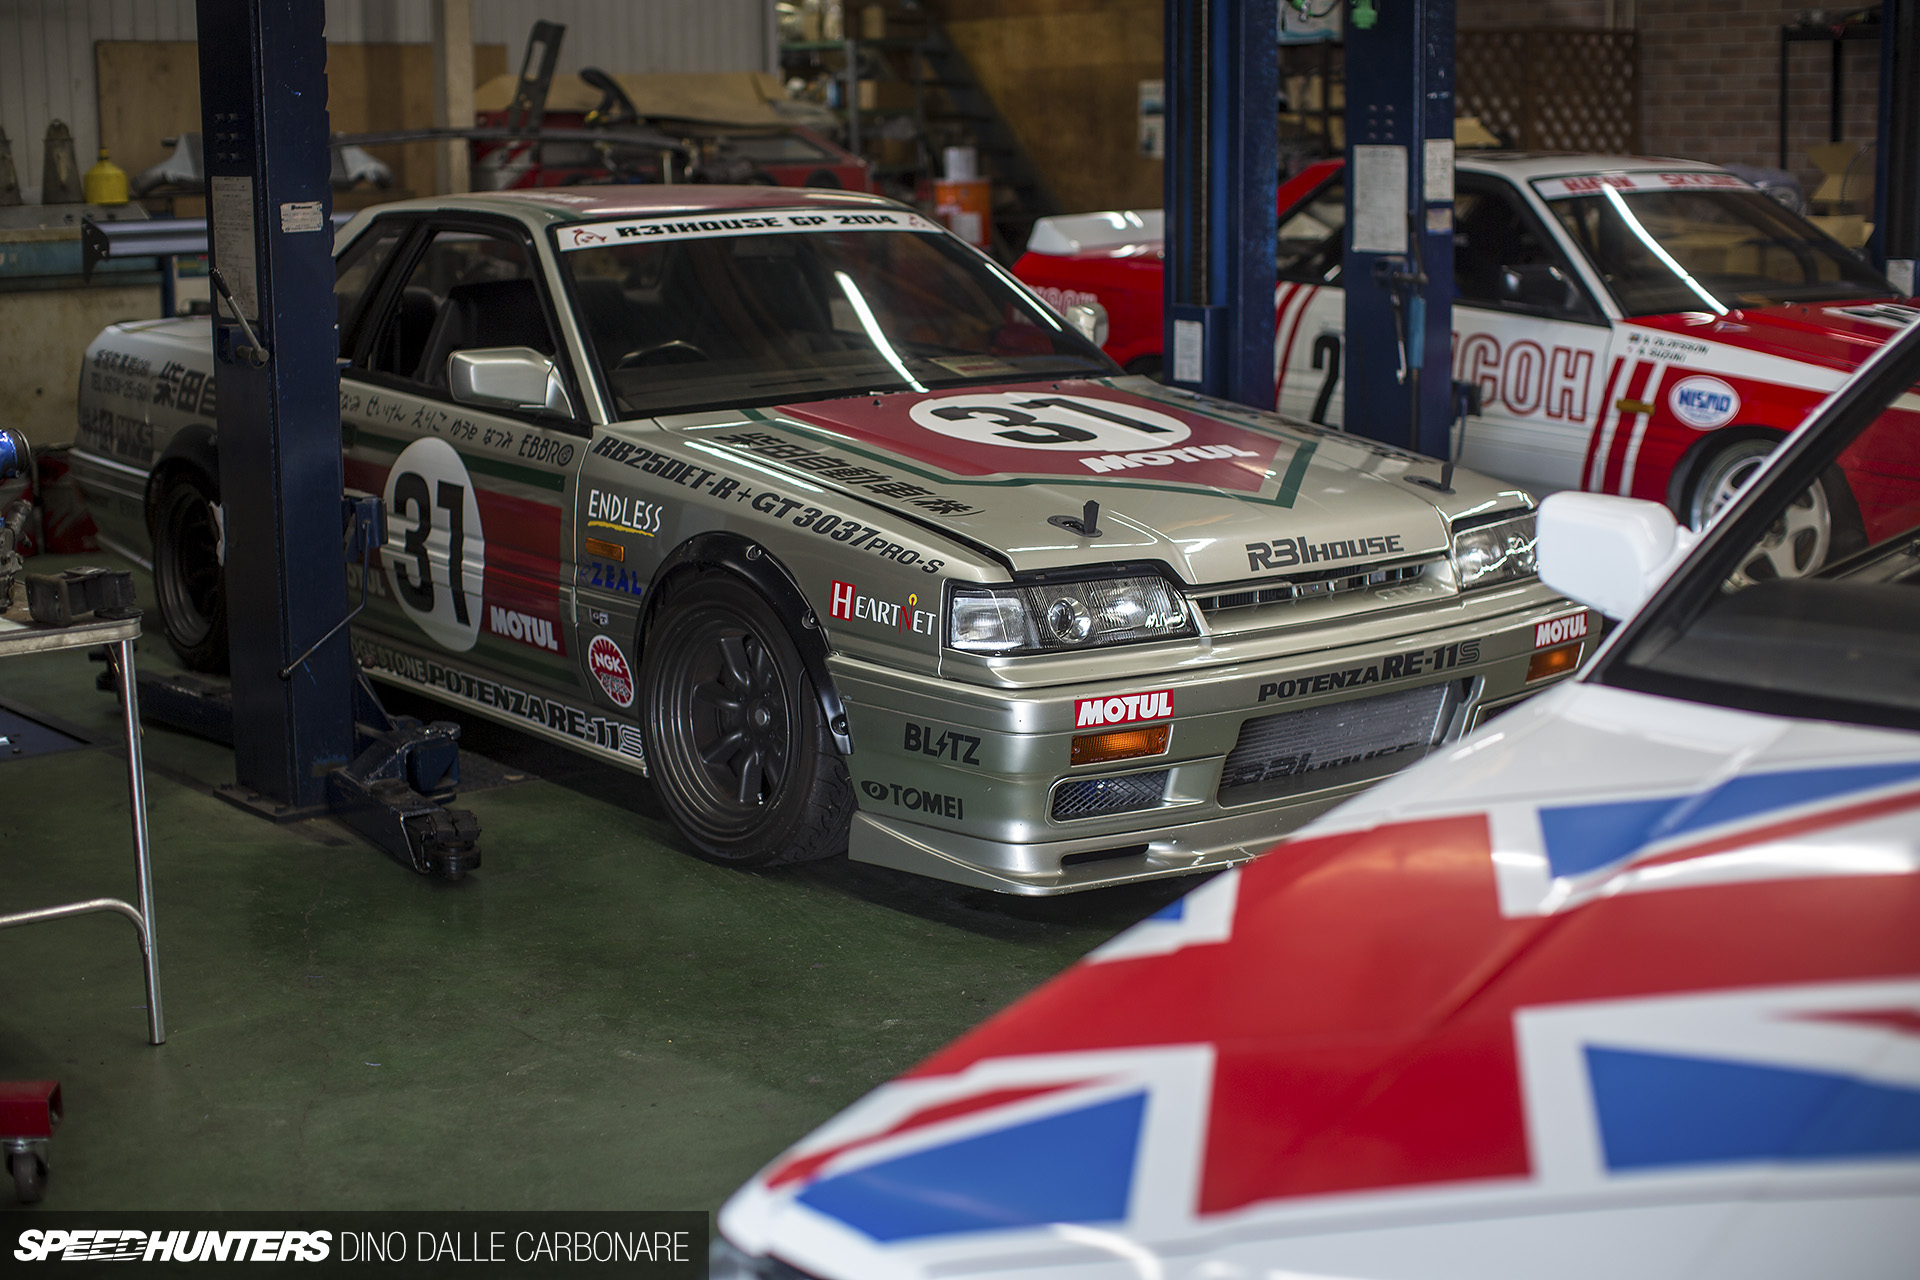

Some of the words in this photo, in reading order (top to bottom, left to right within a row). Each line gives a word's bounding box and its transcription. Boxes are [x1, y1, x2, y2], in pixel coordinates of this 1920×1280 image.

[615, 216, 785, 238] R31HOUSE
[787, 216, 827, 227] GP
[833, 214, 898, 225] 2014
[1679, 389, 1732, 413] NISMO
[1079, 444, 1260, 473] MOTUL
[588, 489, 664, 533] ENDLESS
[1246, 535, 1404, 571] R31HOUSE
[590, 562, 642, 596] ZEAL
[489, 605, 558, 650] MOTUL
[1535, 613, 1588, 647] MOTUL
[594, 652, 622, 674] NGK
[1076, 691, 1172, 726] MOTUL
[904, 722, 981, 766] BLITZ
[889, 783, 963, 820] TOMEI
